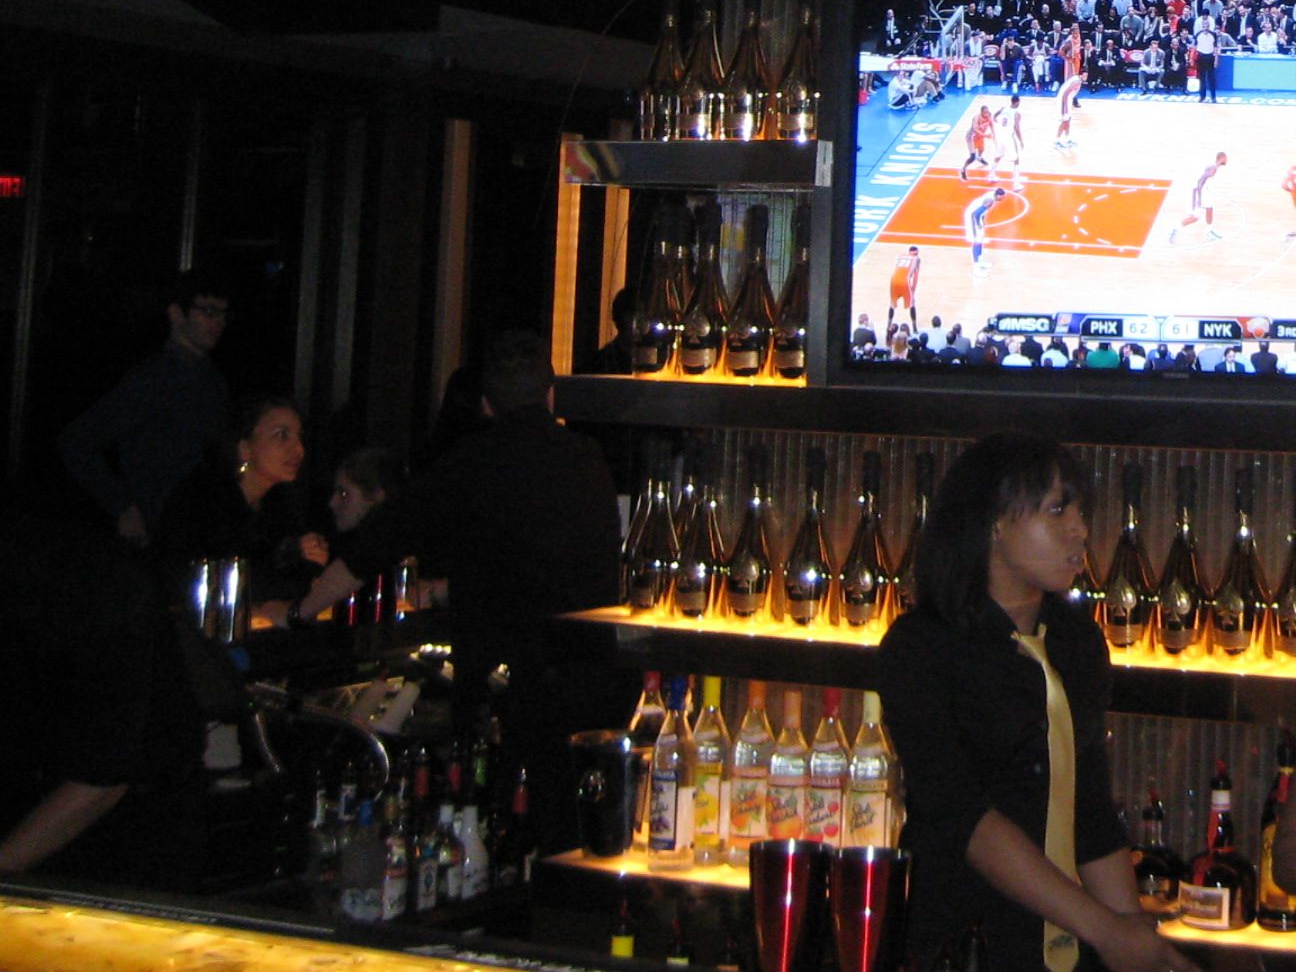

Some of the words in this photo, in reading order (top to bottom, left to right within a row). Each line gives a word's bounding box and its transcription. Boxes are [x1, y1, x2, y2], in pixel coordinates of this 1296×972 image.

[869, 122, 952, 186] KNICKS
[1090, 320, 1118, 335] PHX
[1129, 322, 1148, 334] 62
[1172, 323, 1190, 334] 61
[1203, 323, 1233, 337] NYK
